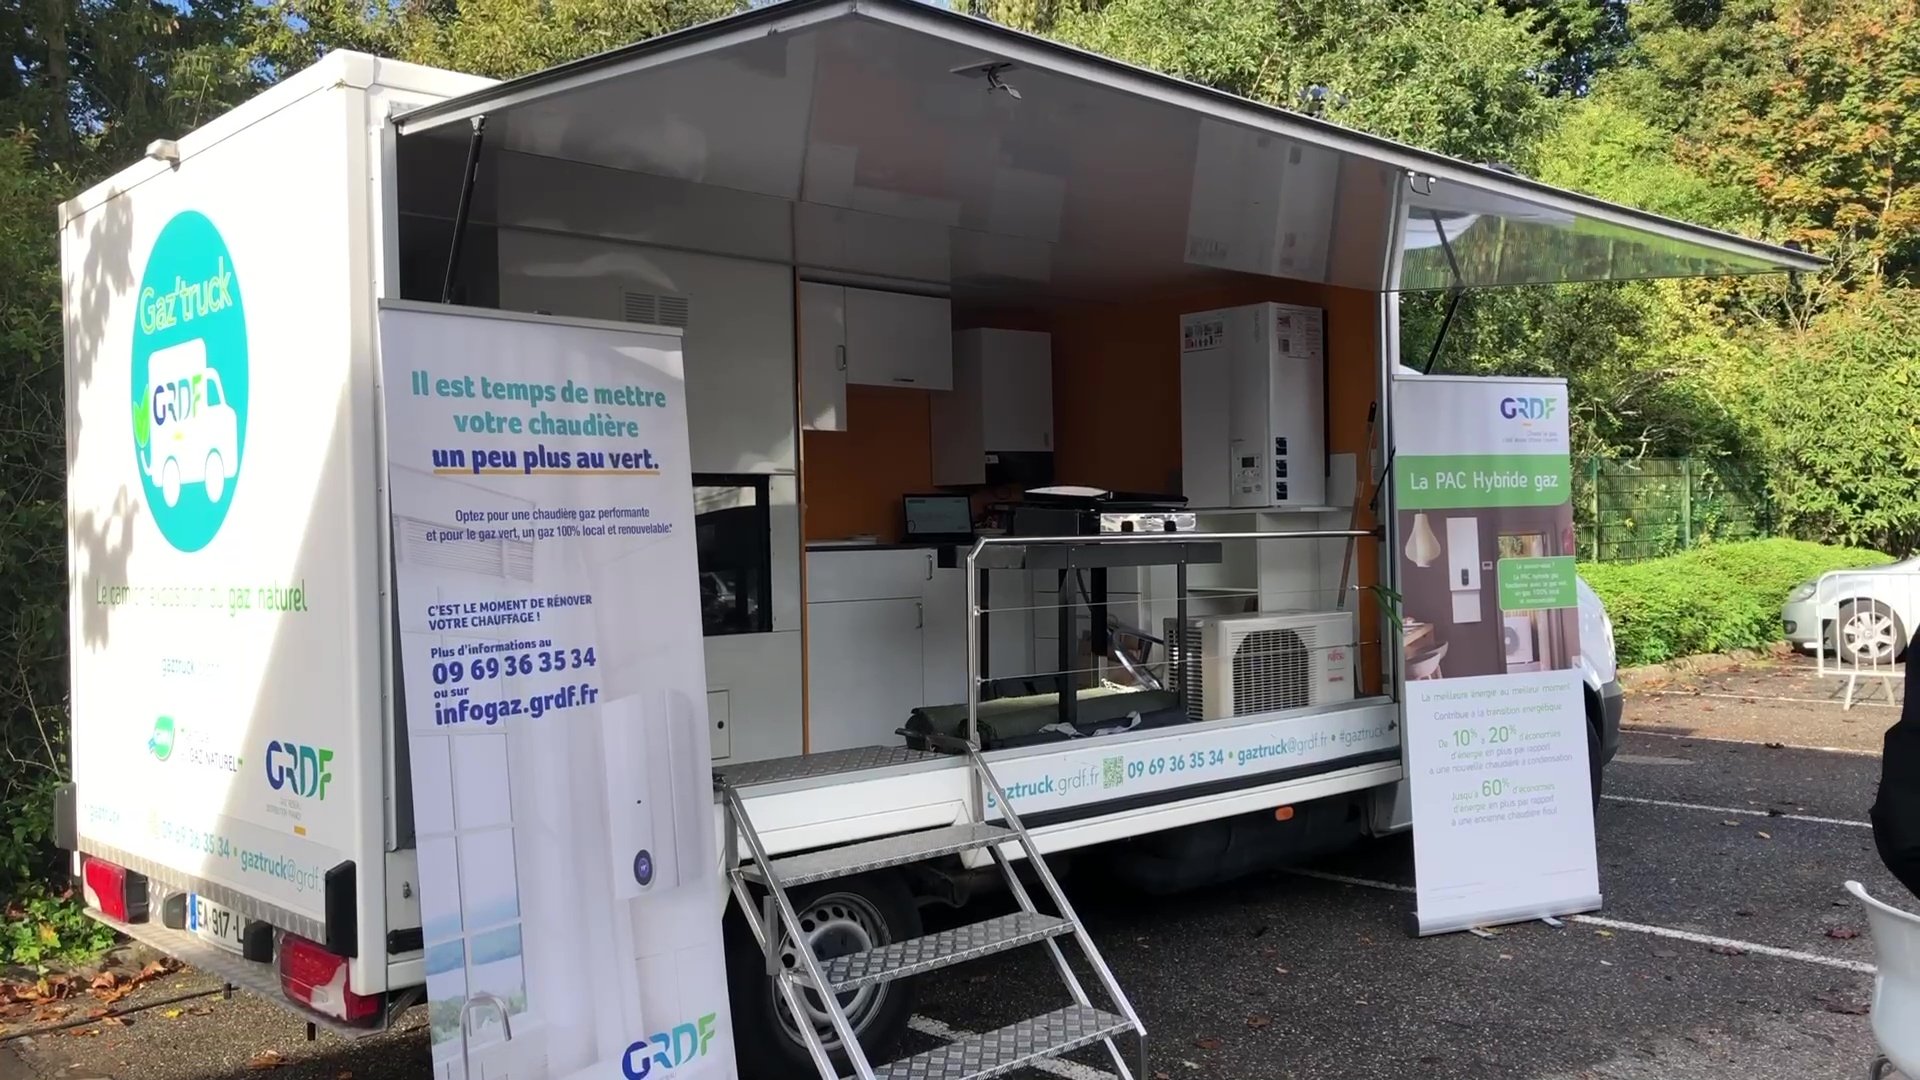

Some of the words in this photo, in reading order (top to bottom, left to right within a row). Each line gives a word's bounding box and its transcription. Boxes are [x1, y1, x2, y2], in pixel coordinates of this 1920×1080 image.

[139, 256, 232, 335] Gaz'truck
[153, 374, 202, 425] GRDF
[412, 370, 428, 396] Il
[435, 376, 475, 398] est
[481, 377, 556, 408] temps
[561, 380, 589, 404] de
[594, 385, 666, 408] mettre
[1501, 397, 1557, 419] GRDF
[453, 411, 522, 434] votre
[529, 411, 639, 437] chaudière
[432, 449, 465, 468] un
[472, 450, 517, 475] peu
[524, 444, 571, 475] plus
[577, 451, 604, 469] au
[609, 449, 659, 469] vert.
[1410, 472, 1428, 490] La
[1436, 471, 1466, 489] PAC
[1473, 471, 1527, 493] Hybride
[1534, 474, 1558, 491] gaz
[455, 510, 485, 524] Optez
[487, 511, 509, 523] pour
[512, 511, 530, 521] une
[532, 507, 577, 521] chaudière
[579, 510, 595, 521] gaz
[599, 507, 649, 521] performante
[426, 531, 437, 542] et
[440, 531, 463, 543] pour
[467, 528, 476, 540] le
[478, 530, 496, 542] gaz
[498, 528, 520, 541] vert,
[522, 528, 535, 538] un
[538, 528, 555, 539] gaz
[557, 526, 581, 537] 100%
[582, 525, 605, 537] local
[607, 525, 616, 535] et
[258, 579, 308, 612] naturel
[428, 604, 461, 617] C'EST
[464, 603, 477, 614] LE
[480, 599, 528, 613] MOMENT
[530, 597, 545, 608] DE
[547, 594, 592, 607] RÉNOVER
[429, 617, 468, 631] VOTRE
[471, 612, 534, 628] CHAUFFAGE
[431, 646, 454, 659] Plus
[457, 638, 536, 656] d'informations
[539, 638, 552, 648] au
[432, 660, 464, 685] 09
[470, 657, 499, 680] 69
[504, 654, 533, 676] 36
[538, 649, 566, 673] 35
[571, 647, 596, 669] 34
[434, 689, 448, 699] ou
[451, 686, 469, 697] sur
[1421, 693, 1431, 702] La
[1433, 690, 1468, 701] meilleure
[1512, 685, 1540, 695] meilleur
[1542, 682, 1570, 692] moment
[435, 683, 598, 725] infogaz.grdf.fr
[1434, 711, 1469, 721] Contribue
[1477, 709, 1485, 717] la
[1486, 706, 1520, 717] transition
[1128, 762, 1144, 779] 09
[1149, 758, 1165, 775] 69
[1169, 754, 1185, 772] 36
[1189, 751, 1205, 768] 35
[1208, 749, 1224, 766] 34
[1238, 733, 1327, 766] gaztruck@grdf.fr
[1339, 726, 1384, 748] #gaztruck
[1438, 739, 1448, 749] De
[1485, 749, 1495, 757] en
[1496, 747, 1513, 757] plus
[1528, 743, 1551, 753] rapport
[266, 740, 334, 801] GRDF
[1436, 765, 1450, 775] une
[1452, 761, 1483, 773] nouvelle
[1528, 754, 1573, 766] condensation
[1488, 801, 1498, 809] en
[1500, 799, 1516, 809] plus
[1530, 794, 1554, 805] rapport
[1458, 817, 1472, 826] une
[1474, 813, 1506, 824] ancienne
[203, 832, 215, 854] 35
[218, 836, 230, 858] 34
[241, 850, 326, 893] gaztruck@grdf.
[622, 1012, 716, 1080] GRDF
